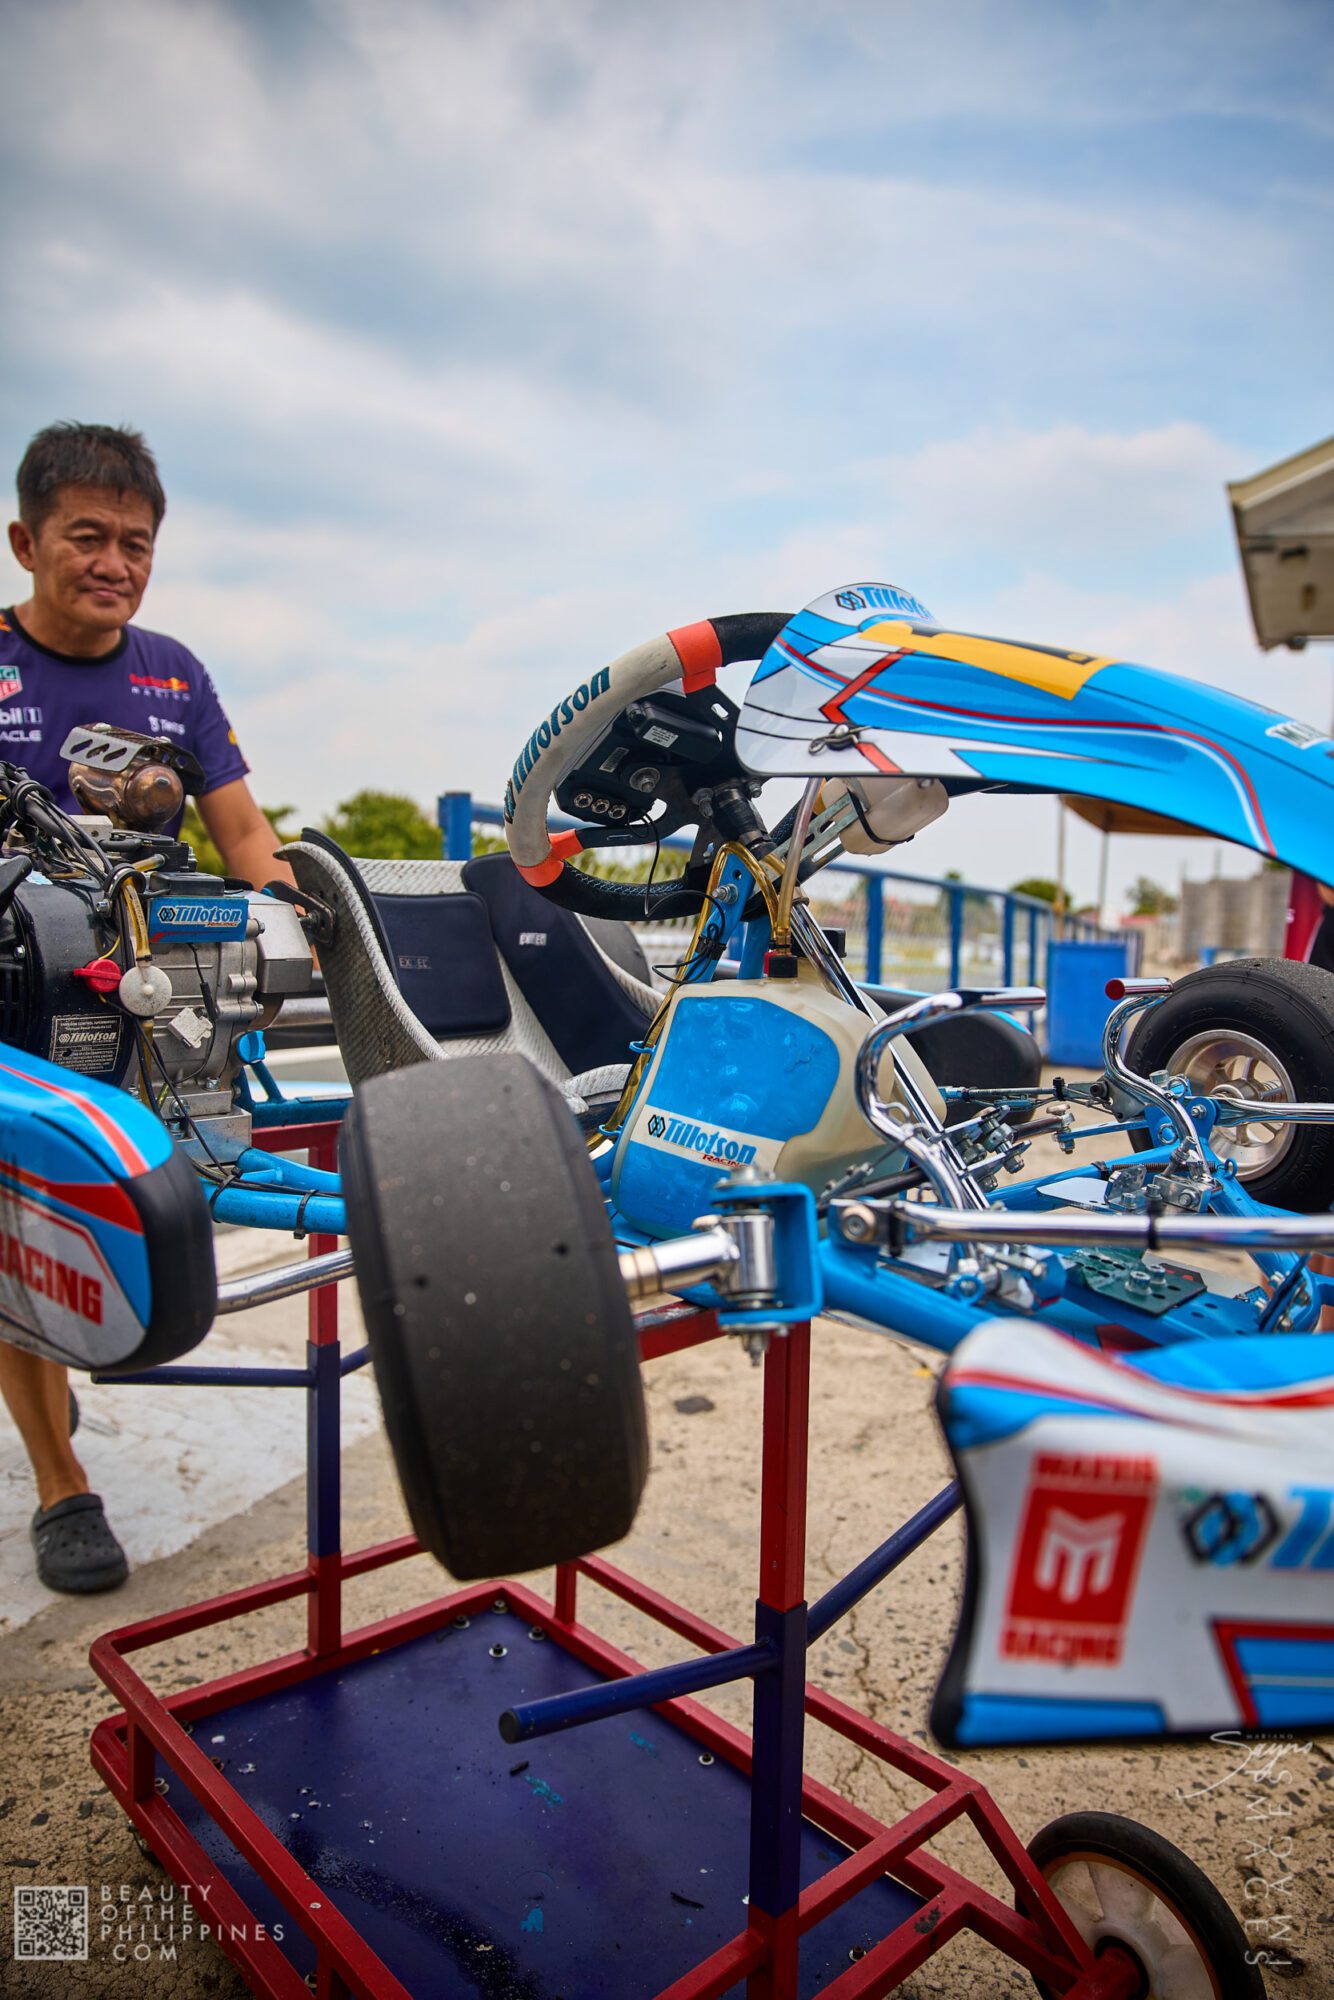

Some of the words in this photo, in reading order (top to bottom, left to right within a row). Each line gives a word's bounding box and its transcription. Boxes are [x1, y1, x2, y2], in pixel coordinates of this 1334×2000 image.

[857, 586, 934, 619] Tillot
[174, 905, 241, 922] Tillotson
[70, 1032, 117, 1043] Tillotson
[662, 1117, 758, 1165] Tillotson
